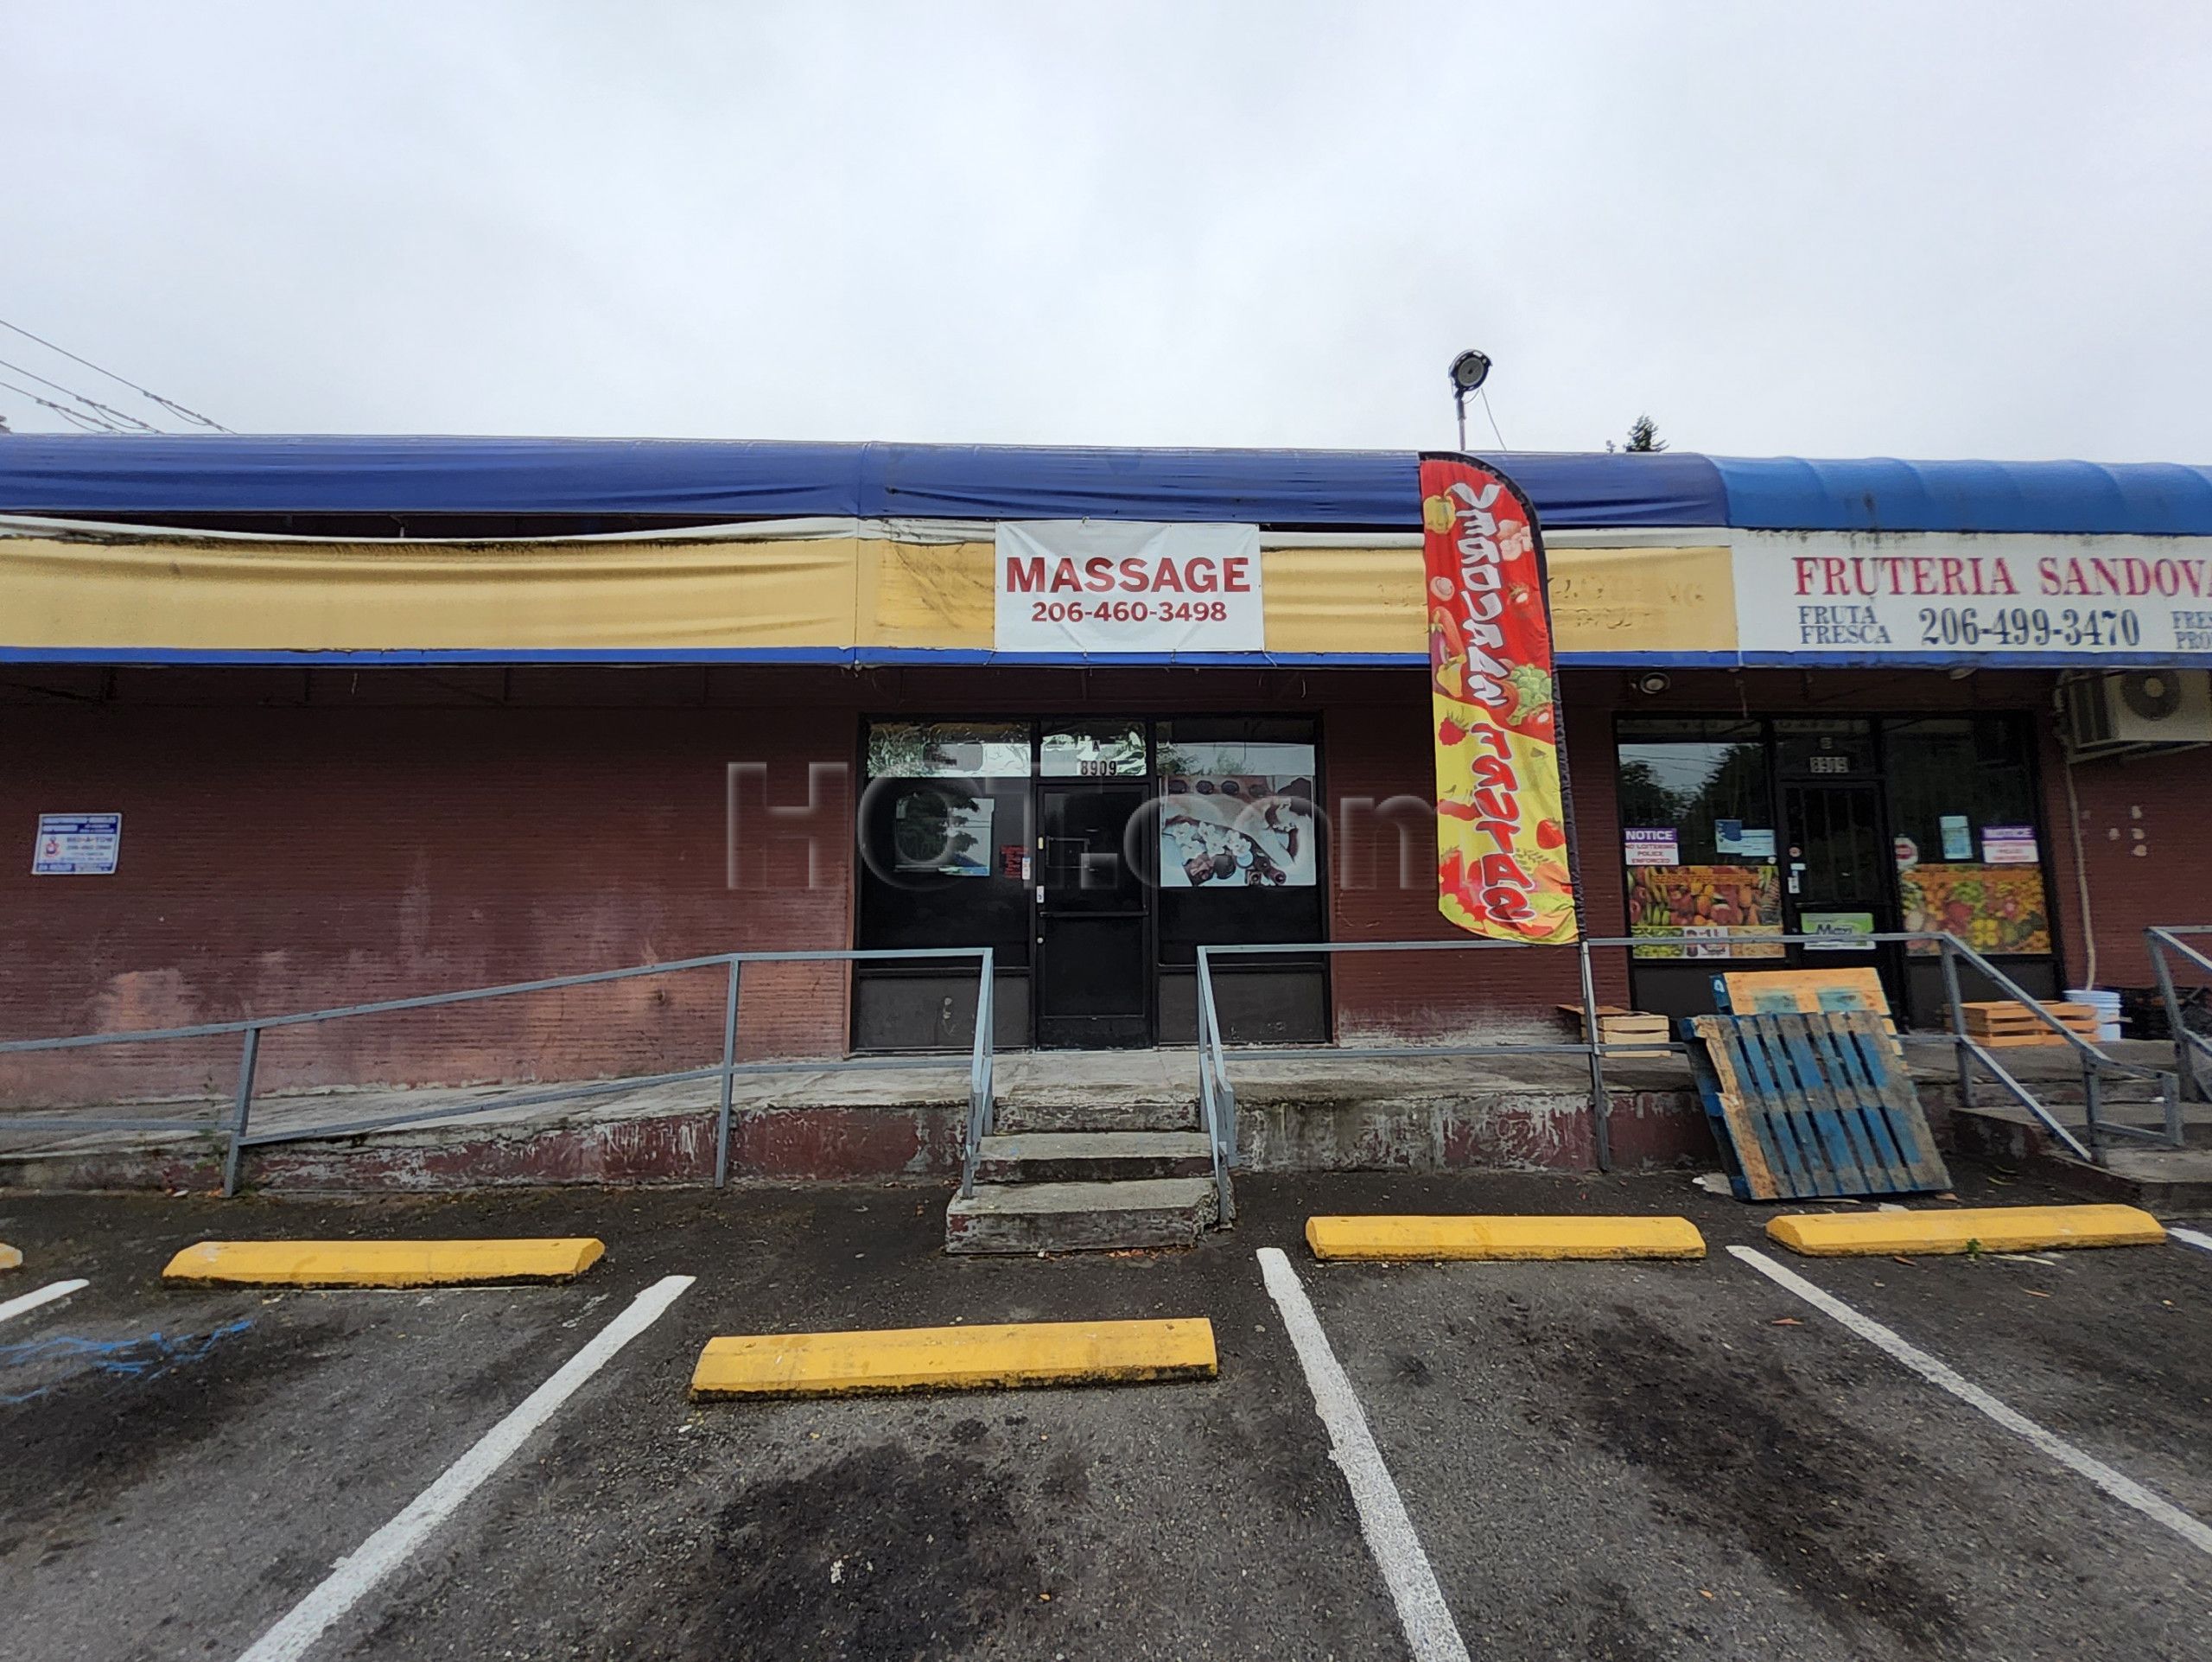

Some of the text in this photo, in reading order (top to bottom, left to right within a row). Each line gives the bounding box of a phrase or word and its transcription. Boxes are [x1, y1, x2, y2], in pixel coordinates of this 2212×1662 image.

[1006, 556, 1250, 594] MASSAGE
[1792, 556, 2212, 598] FRUTERIA SANDOV
[1031, 601, 1228, 622] 206-460-3498
[1798, 605, 1878, 625] FRUTA
[1799, 625, 1893, 645] FRESCA
[1918, 606, 2141, 646] 206-499-3470
[1092, 740, 1101, 752] A
[1081, 761, 1117, 775] 8909
[1625, 830, 1675, 841] NOTICE
